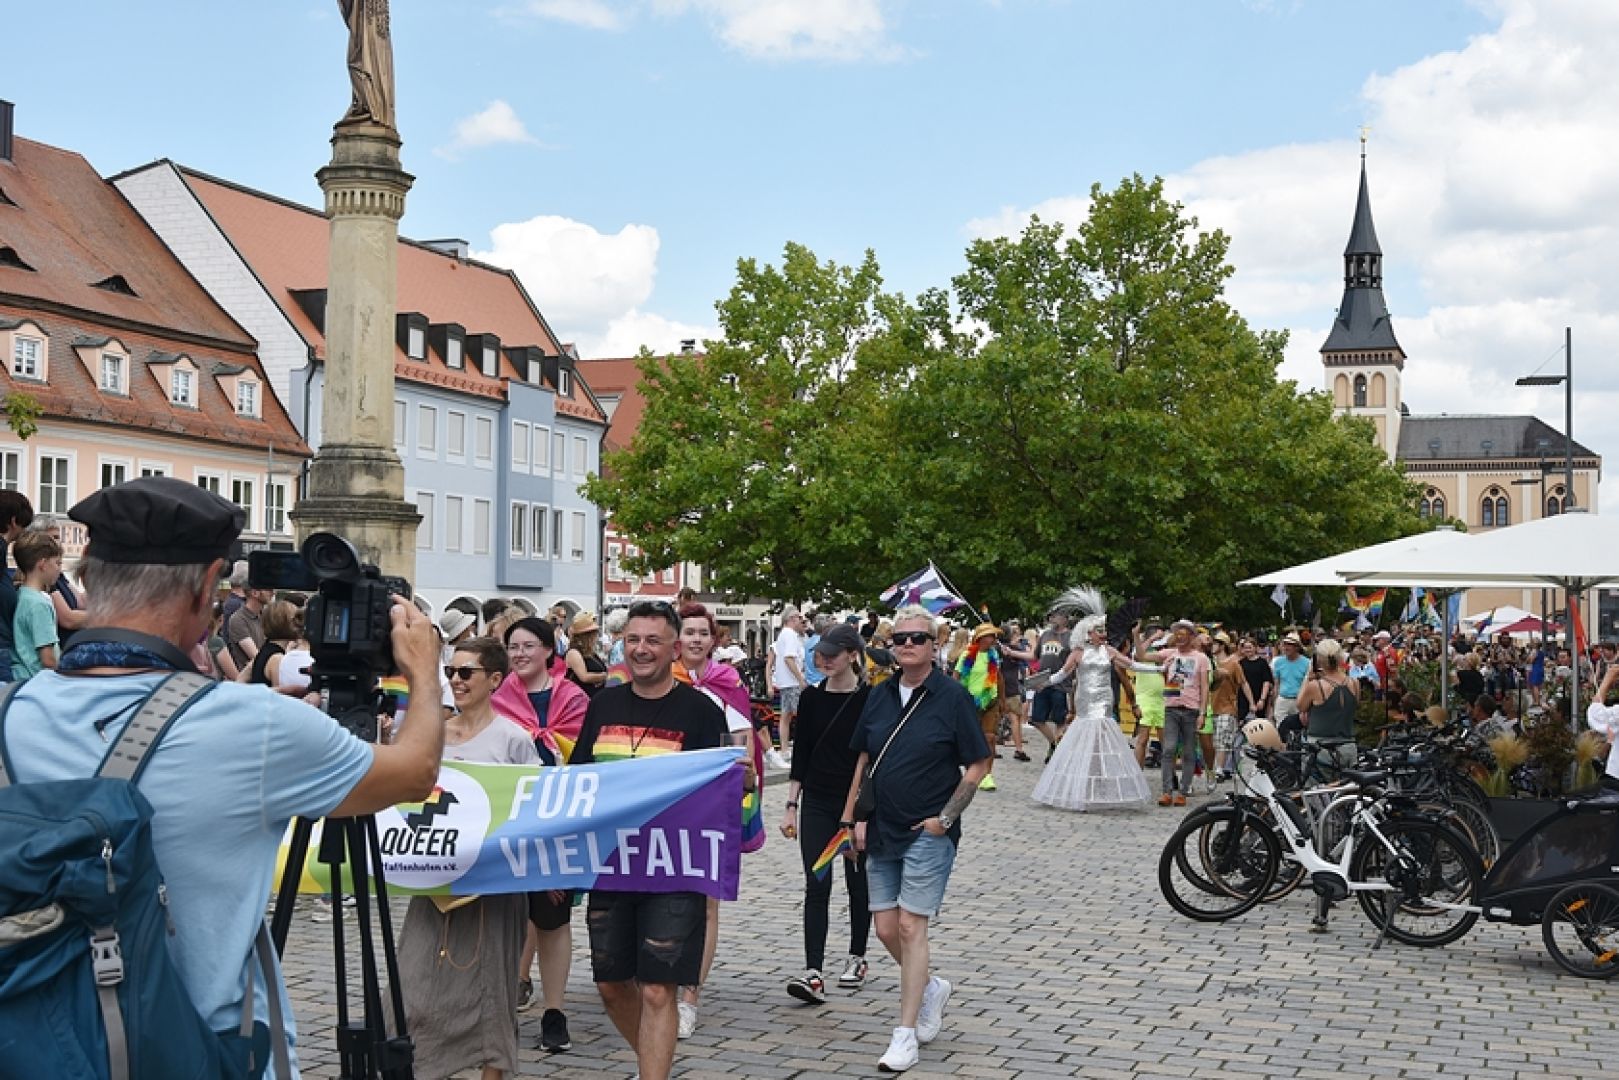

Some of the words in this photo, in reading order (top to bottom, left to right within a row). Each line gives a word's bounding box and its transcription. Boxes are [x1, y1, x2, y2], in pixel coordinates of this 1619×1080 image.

[508, 766, 600, 821] FÜR
[381, 827, 459, 857] QUEER
[500, 827, 725, 881] VIELFALT
